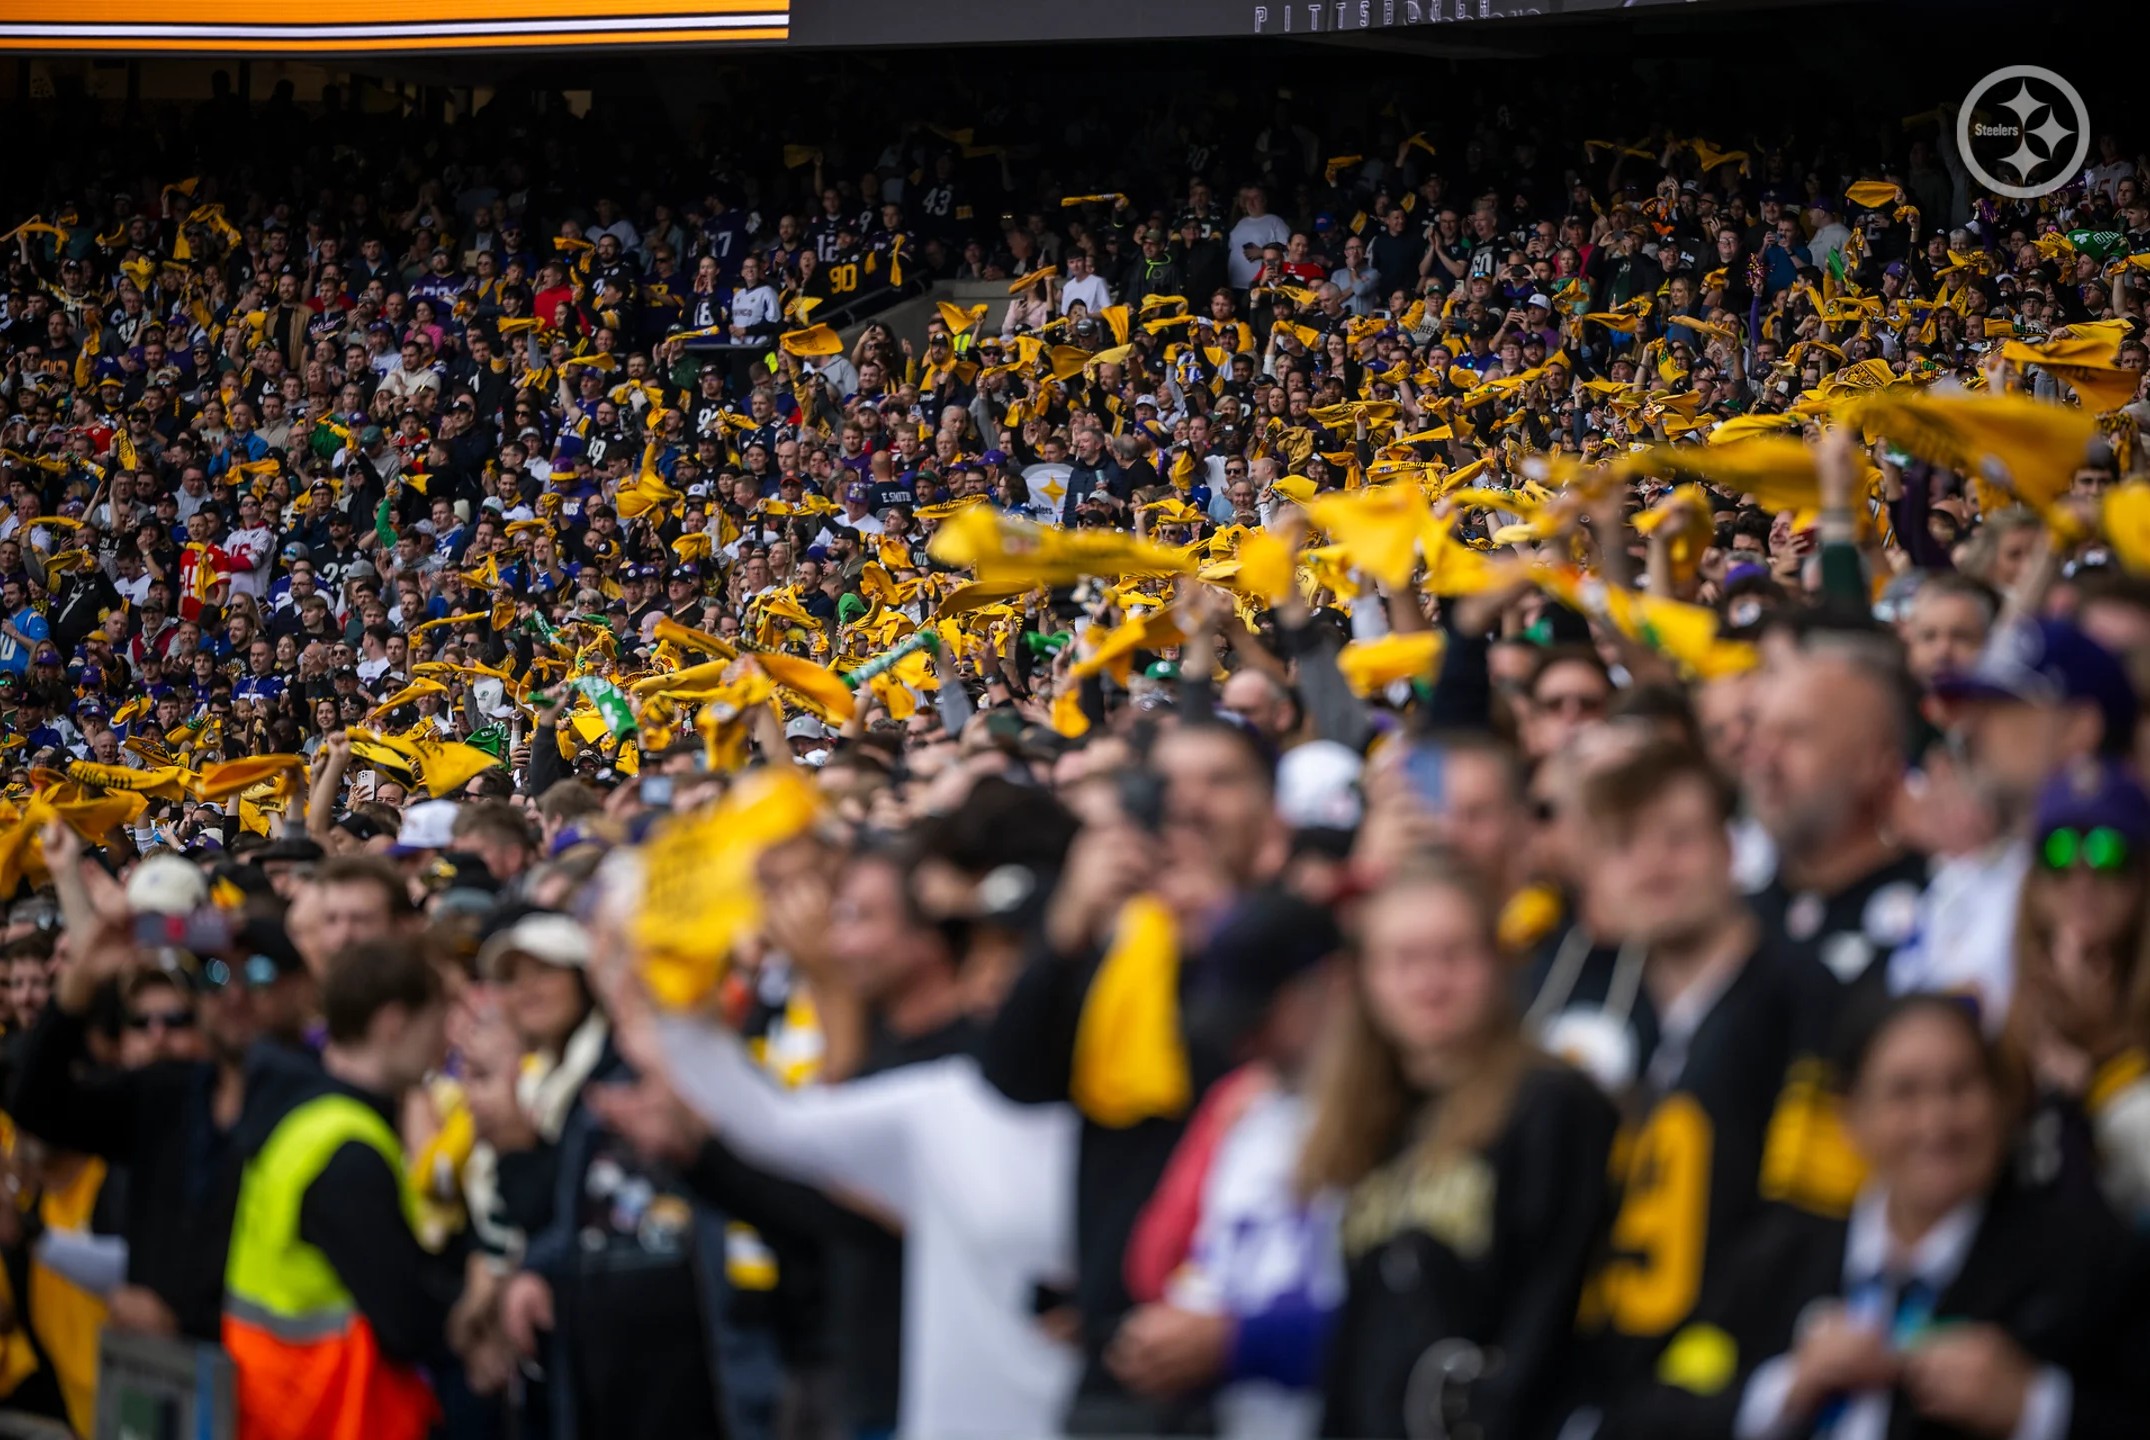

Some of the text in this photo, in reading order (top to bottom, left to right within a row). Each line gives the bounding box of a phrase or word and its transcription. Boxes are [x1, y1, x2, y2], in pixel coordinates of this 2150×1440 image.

[922, 187, 952, 216] 43
[827, 262, 858, 295] 90
[881, 490, 912, 503] E.SMITH
[1035, 504, 1053, 515] elers
